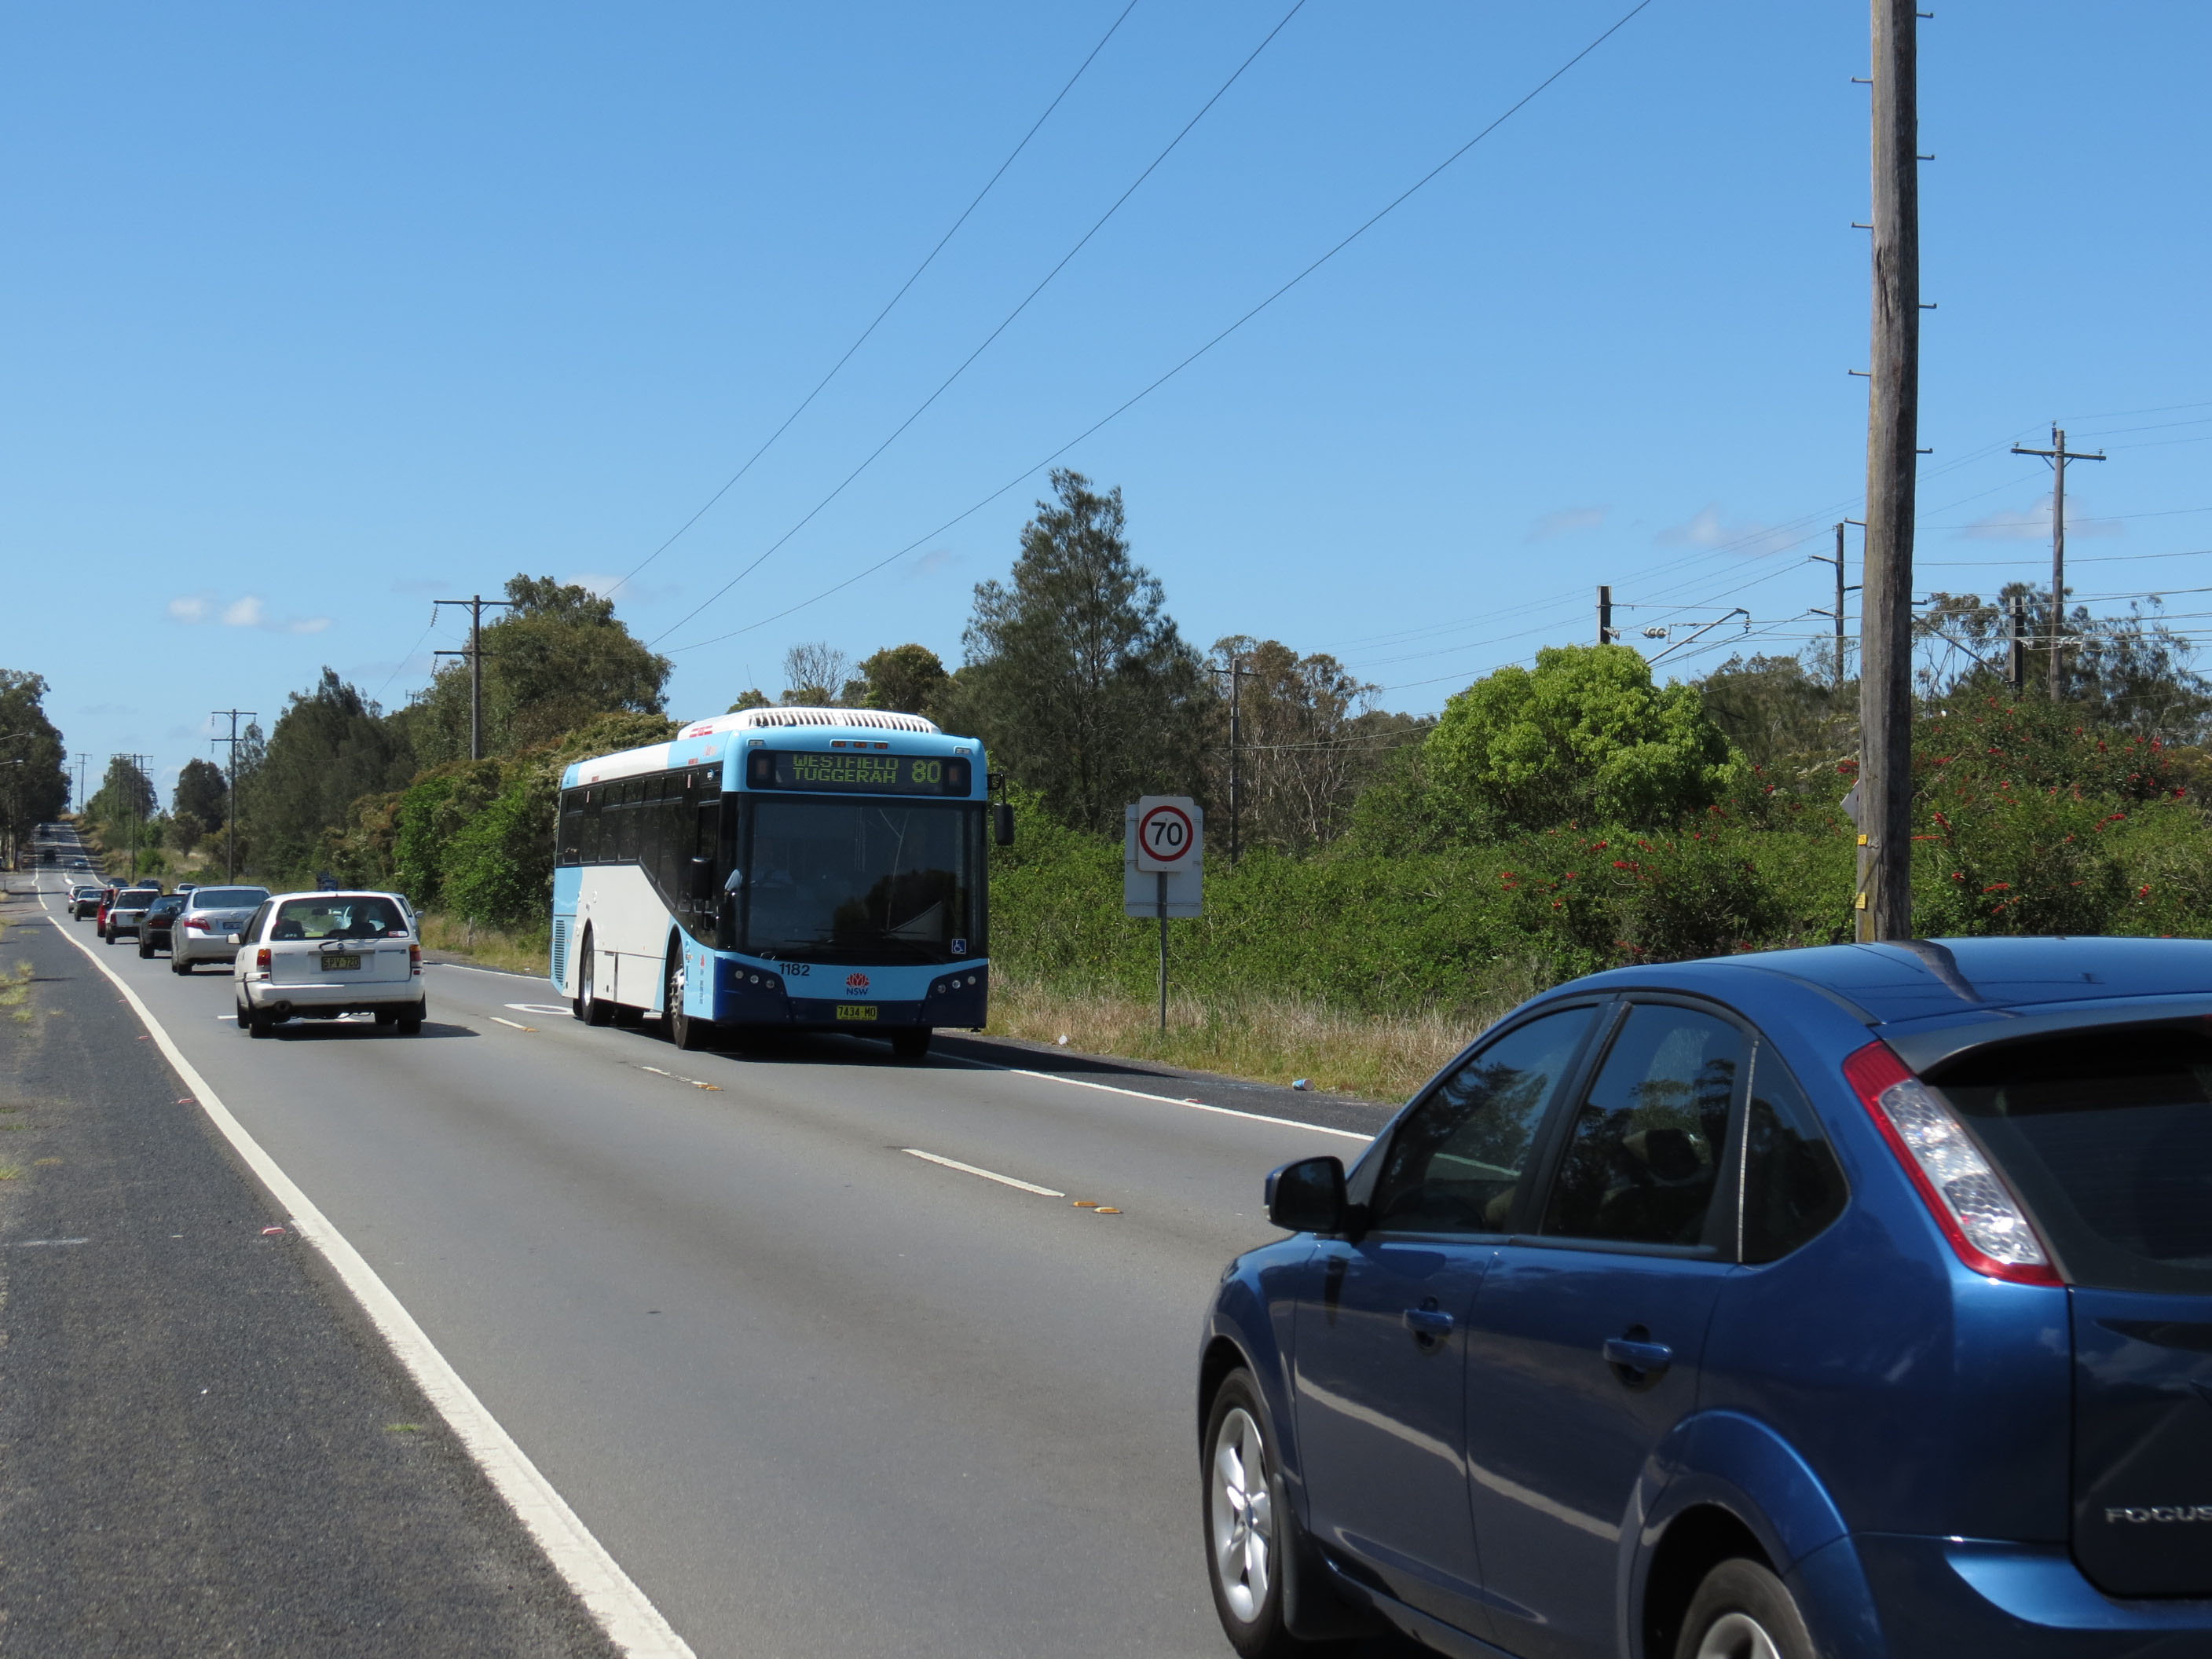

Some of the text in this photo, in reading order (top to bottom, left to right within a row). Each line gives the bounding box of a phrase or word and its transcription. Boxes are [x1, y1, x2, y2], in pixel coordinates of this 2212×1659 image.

[793, 753, 899, 770] WESTFIELD
[793, 767, 897, 784] TUGGERAH
[911, 760, 942, 784] 80
[1151, 822, 1183, 846] 70
[778, 962, 811, 976] 1182
[2104, 1505, 2212, 1524] FOCUS
